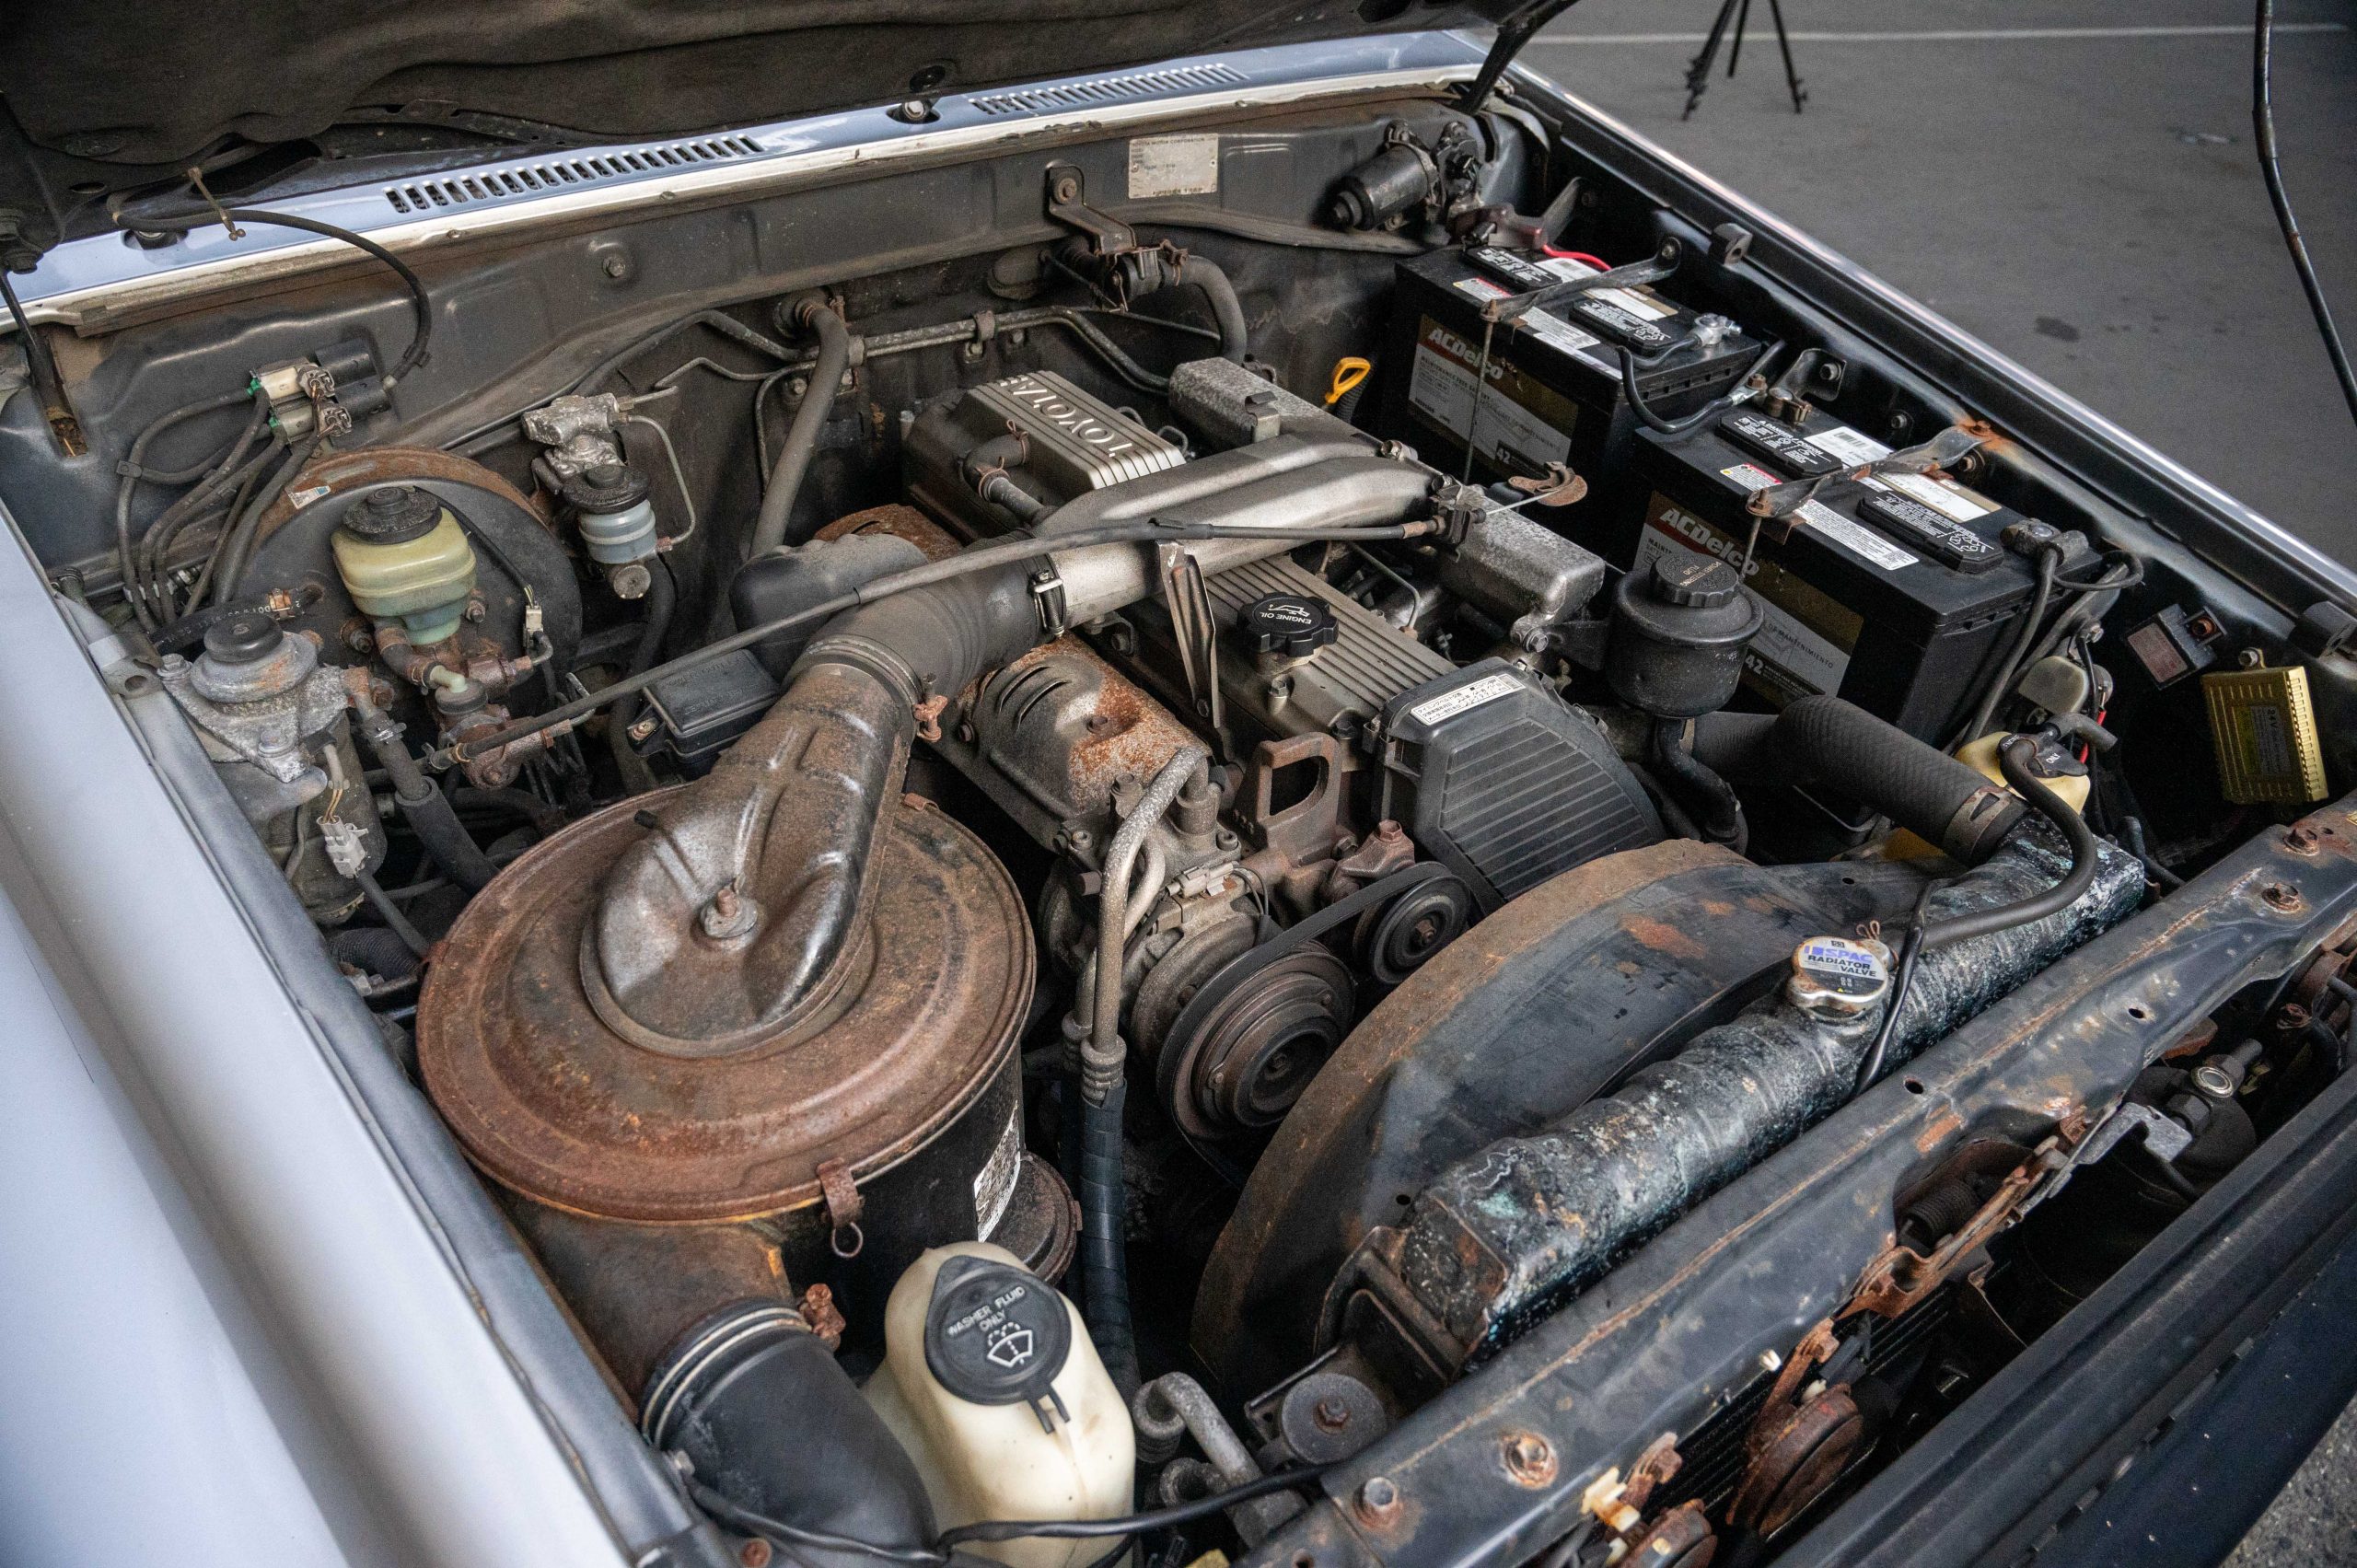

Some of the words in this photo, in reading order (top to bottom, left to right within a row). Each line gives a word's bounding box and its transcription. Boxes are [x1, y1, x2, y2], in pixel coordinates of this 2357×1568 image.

[1013, 380, 1132, 458] TOYOTA
[1275, 613, 1312, 624] ENGINE
[1745, 654, 1764, 675] 42
[2267, 708, 2278, 729] 24V
[1807, 955, 1871, 970] RADIATOR
[1840, 965, 1877, 977] VALVE
[947, 1305, 993, 1337] WASHER
[994, 1286, 1026, 1308] FLUID
[979, 1309, 1006, 1332] ONLY
